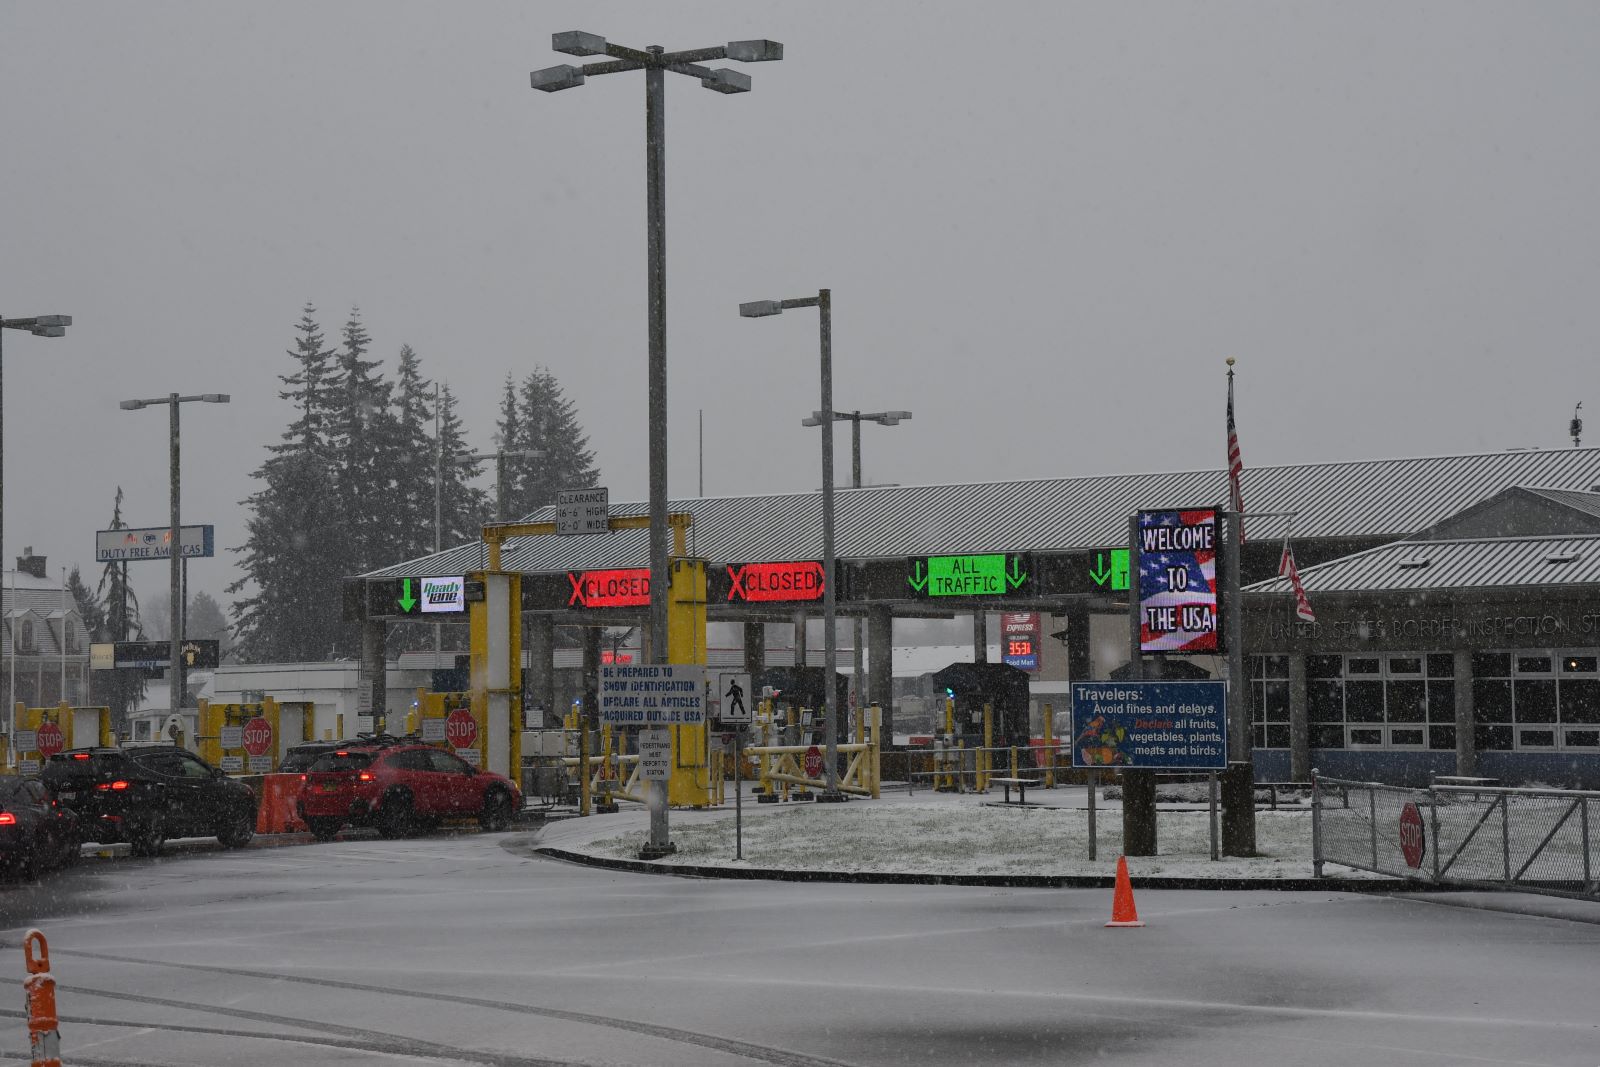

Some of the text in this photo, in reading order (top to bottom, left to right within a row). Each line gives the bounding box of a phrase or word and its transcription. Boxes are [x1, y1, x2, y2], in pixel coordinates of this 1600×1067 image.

[560, 493, 605, 504] CLEARANCE
[586, 507, 605, 516] HIGH
[587, 520, 605, 529] WIDE
[1143, 526, 1212, 551] WELCOME
[102, 545, 200, 558] DUTY FREE AMICAS
[953, 559, 980, 574] ALL
[747, 572, 815, 591] CLOSED
[936, 576, 998, 592] TRAFFIC
[1167, 567, 1187, 590] TO
[587, 578, 650, 597] CLOSED
[1148, 607, 1212, 630] THE USA
[1006, 624, 1034, 632] EXPRESS
[1271, 621, 1322, 640] UNITED
[1393, 618, 1461, 638] BORDER
[1468, 615, 1570, 636] INSPECTION
[603, 667, 673, 678] BE PREPARED TO
[603, 681, 695, 692] SHOW IDENTIFICATION
[1077, 687, 1144, 701] Travelers:
[603, 697, 701, 708] DECLARE ALL ARTICLES
[604, 711, 701, 721] ACQUIRED OUTSIDE USA
[1093, 703, 1218, 716] Avoid fines and delays.
[448, 722, 475, 737] STOP
[1135, 719, 1219, 731] Declare all fruits,
[39, 733, 63, 748] STOP
[245, 730, 270, 745] STOP
[1129, 732, 1225, 744] vegetables, plants,
[1135, 745, 1220, 756] meats and birds.
[1401, 822, 1420, 848] STOP
